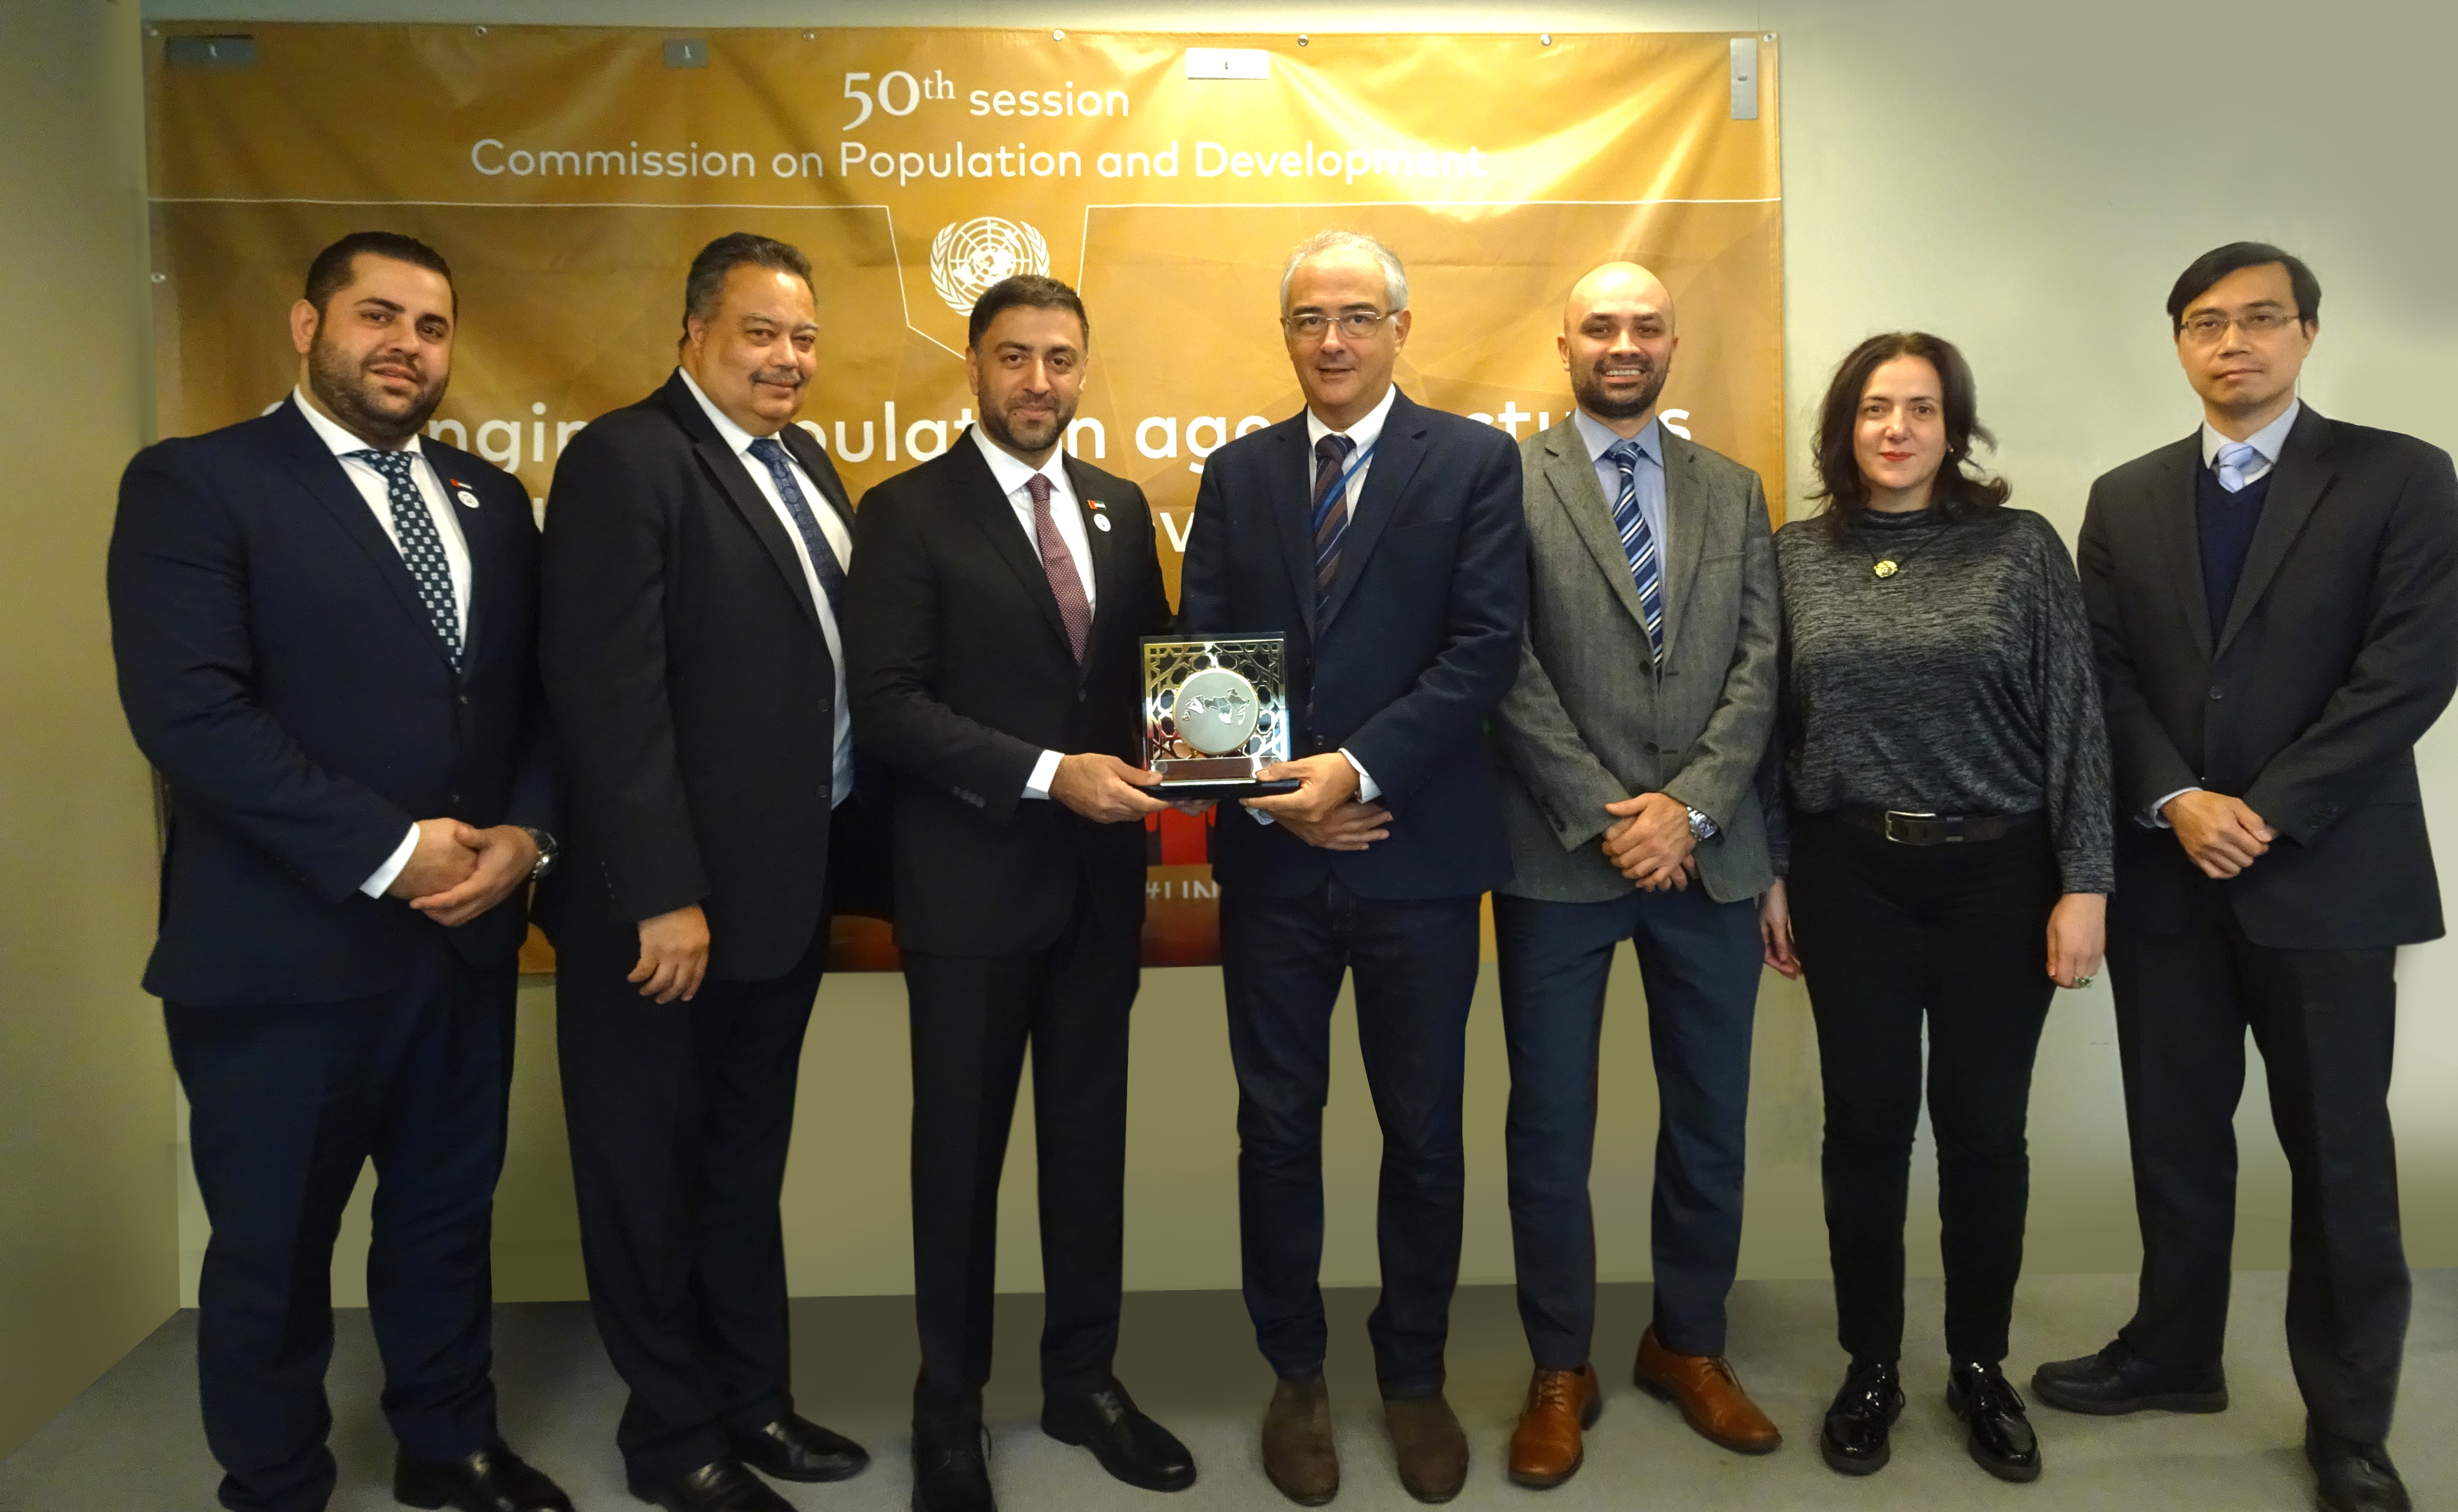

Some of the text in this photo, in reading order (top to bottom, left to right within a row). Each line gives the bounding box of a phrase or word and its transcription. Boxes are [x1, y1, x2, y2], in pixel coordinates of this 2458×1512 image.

[842, 69, 1129, 131] 50th session
[471, 139, 1488, 186] Commission on Population and Development
